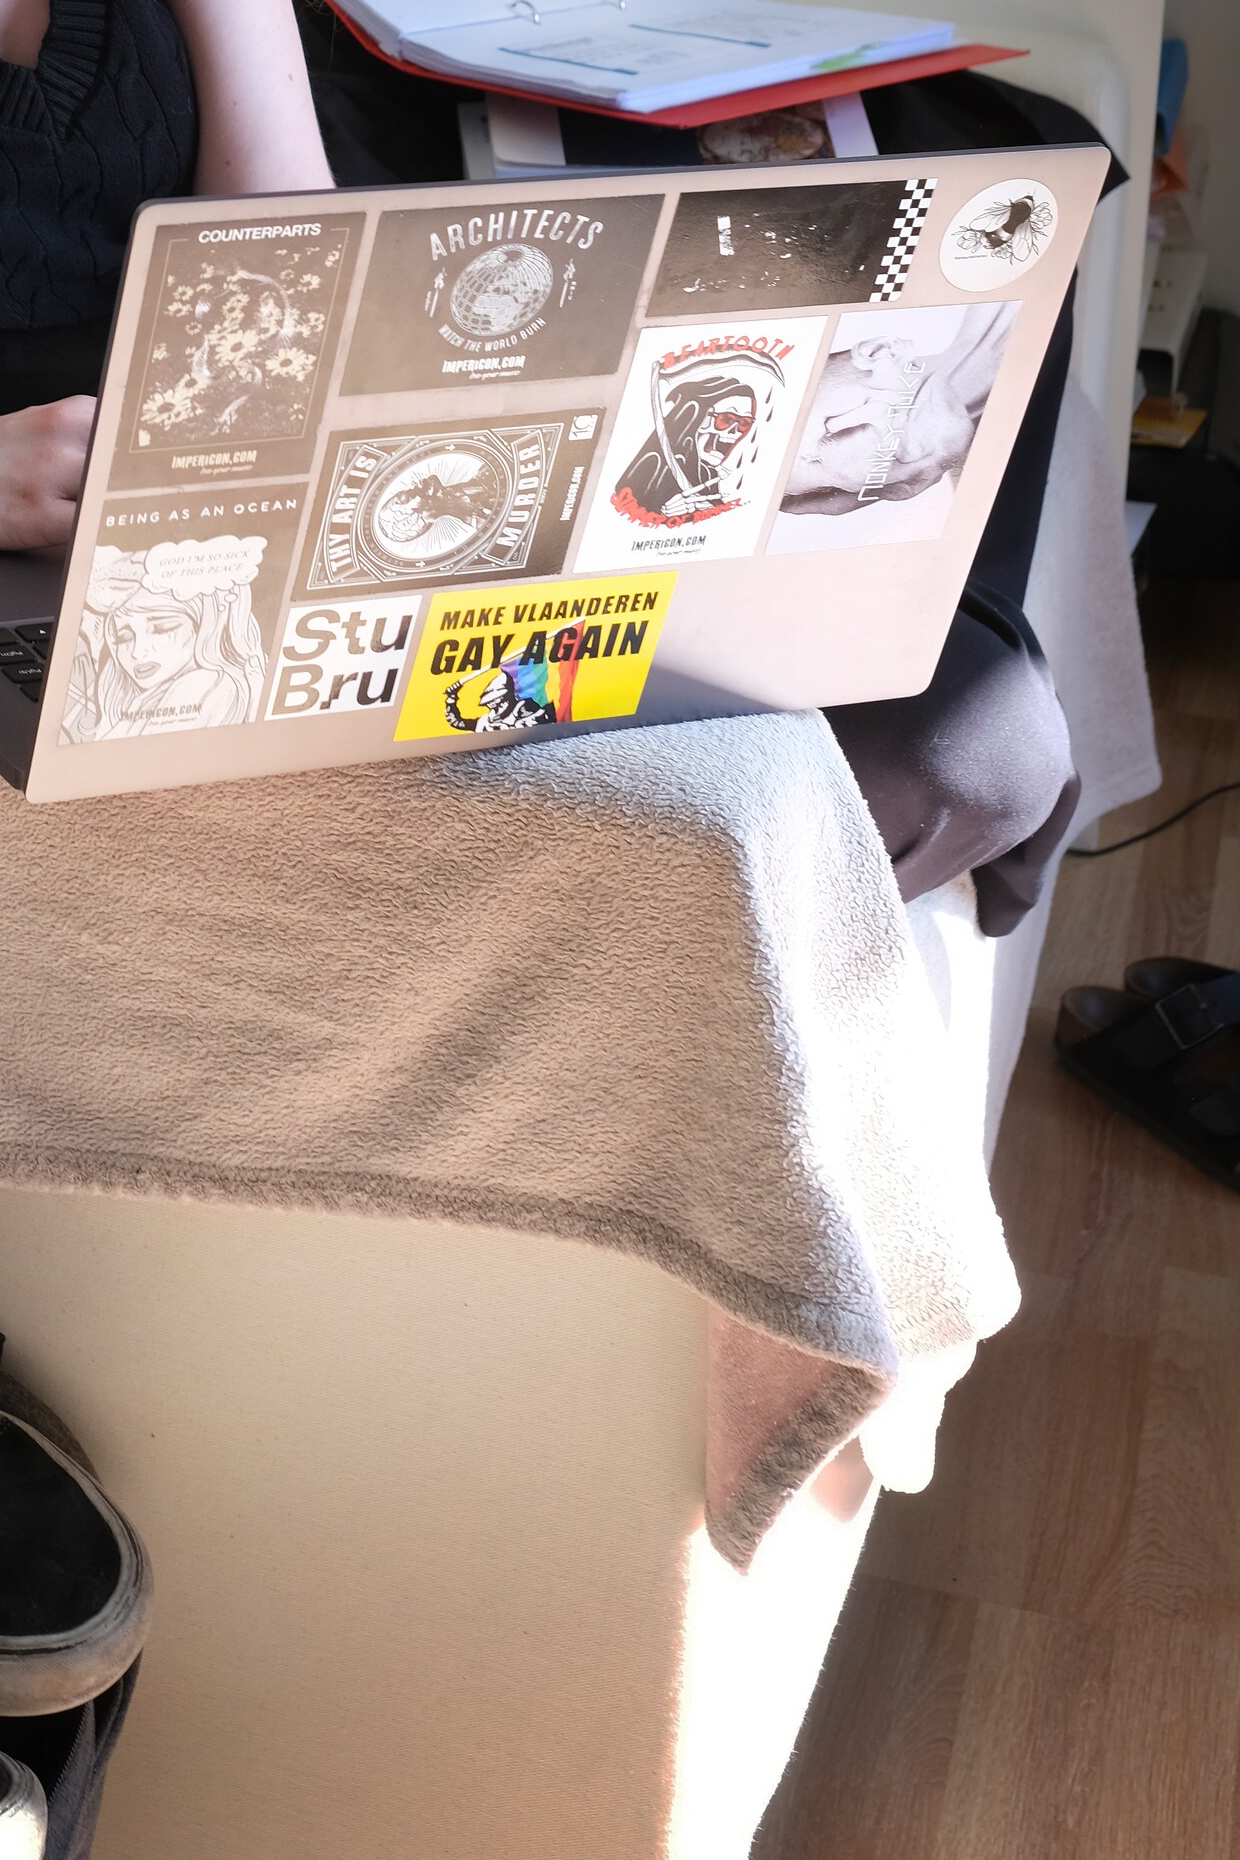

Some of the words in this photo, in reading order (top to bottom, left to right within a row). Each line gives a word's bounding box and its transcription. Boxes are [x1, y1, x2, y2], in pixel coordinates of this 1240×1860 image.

[198, 223, 322, 243] COUNTERPARTS
[429, 208, 604, 261] ARCHITECTS
[464, 339, 483, 352] THE
[484, 335, 518, 352] WORLD
[519, 317, 547, 340] BURN
[441, 355, 526, 374] IMPERICON.COM
[660, 335, 795, 370] BEARTOOTH
[171, 450, 257, 469] IMPERICON.COM
[350, 454, 377, 478] IS
[334, 484, 360, 524] ART
[497, 442, 541, 548] MURDER
[105, 511, 160, 528] BEING
[168, 508, 191, 521] AS
[200, 505, 224, 518] AN
[233, 498, 298, 515] OCEAN
[159, 556, 185, 567] GOD
[187, 554, 205, 564] I'M
[206, 552, 222, 561] SO
[223, 549, 250, 560] SICK
[328, 532, 352, 573] THY
[631, 535, 707, 552] IMPERICON.COM
[160, 569, 177, 579] OF
[180, 566, 205, 577] THIS
[207, 563, 244, 574] PLACE
[439, 607, 505, 632] MAKE
[513, 591, 660, 624] VLAANDEREN
[282, 608, 413, 662] Stu
[429, 633, 515, 677] GAY
[519, 619, 651, 667] AGAIN
[271, 662, 398, 715] Bru
